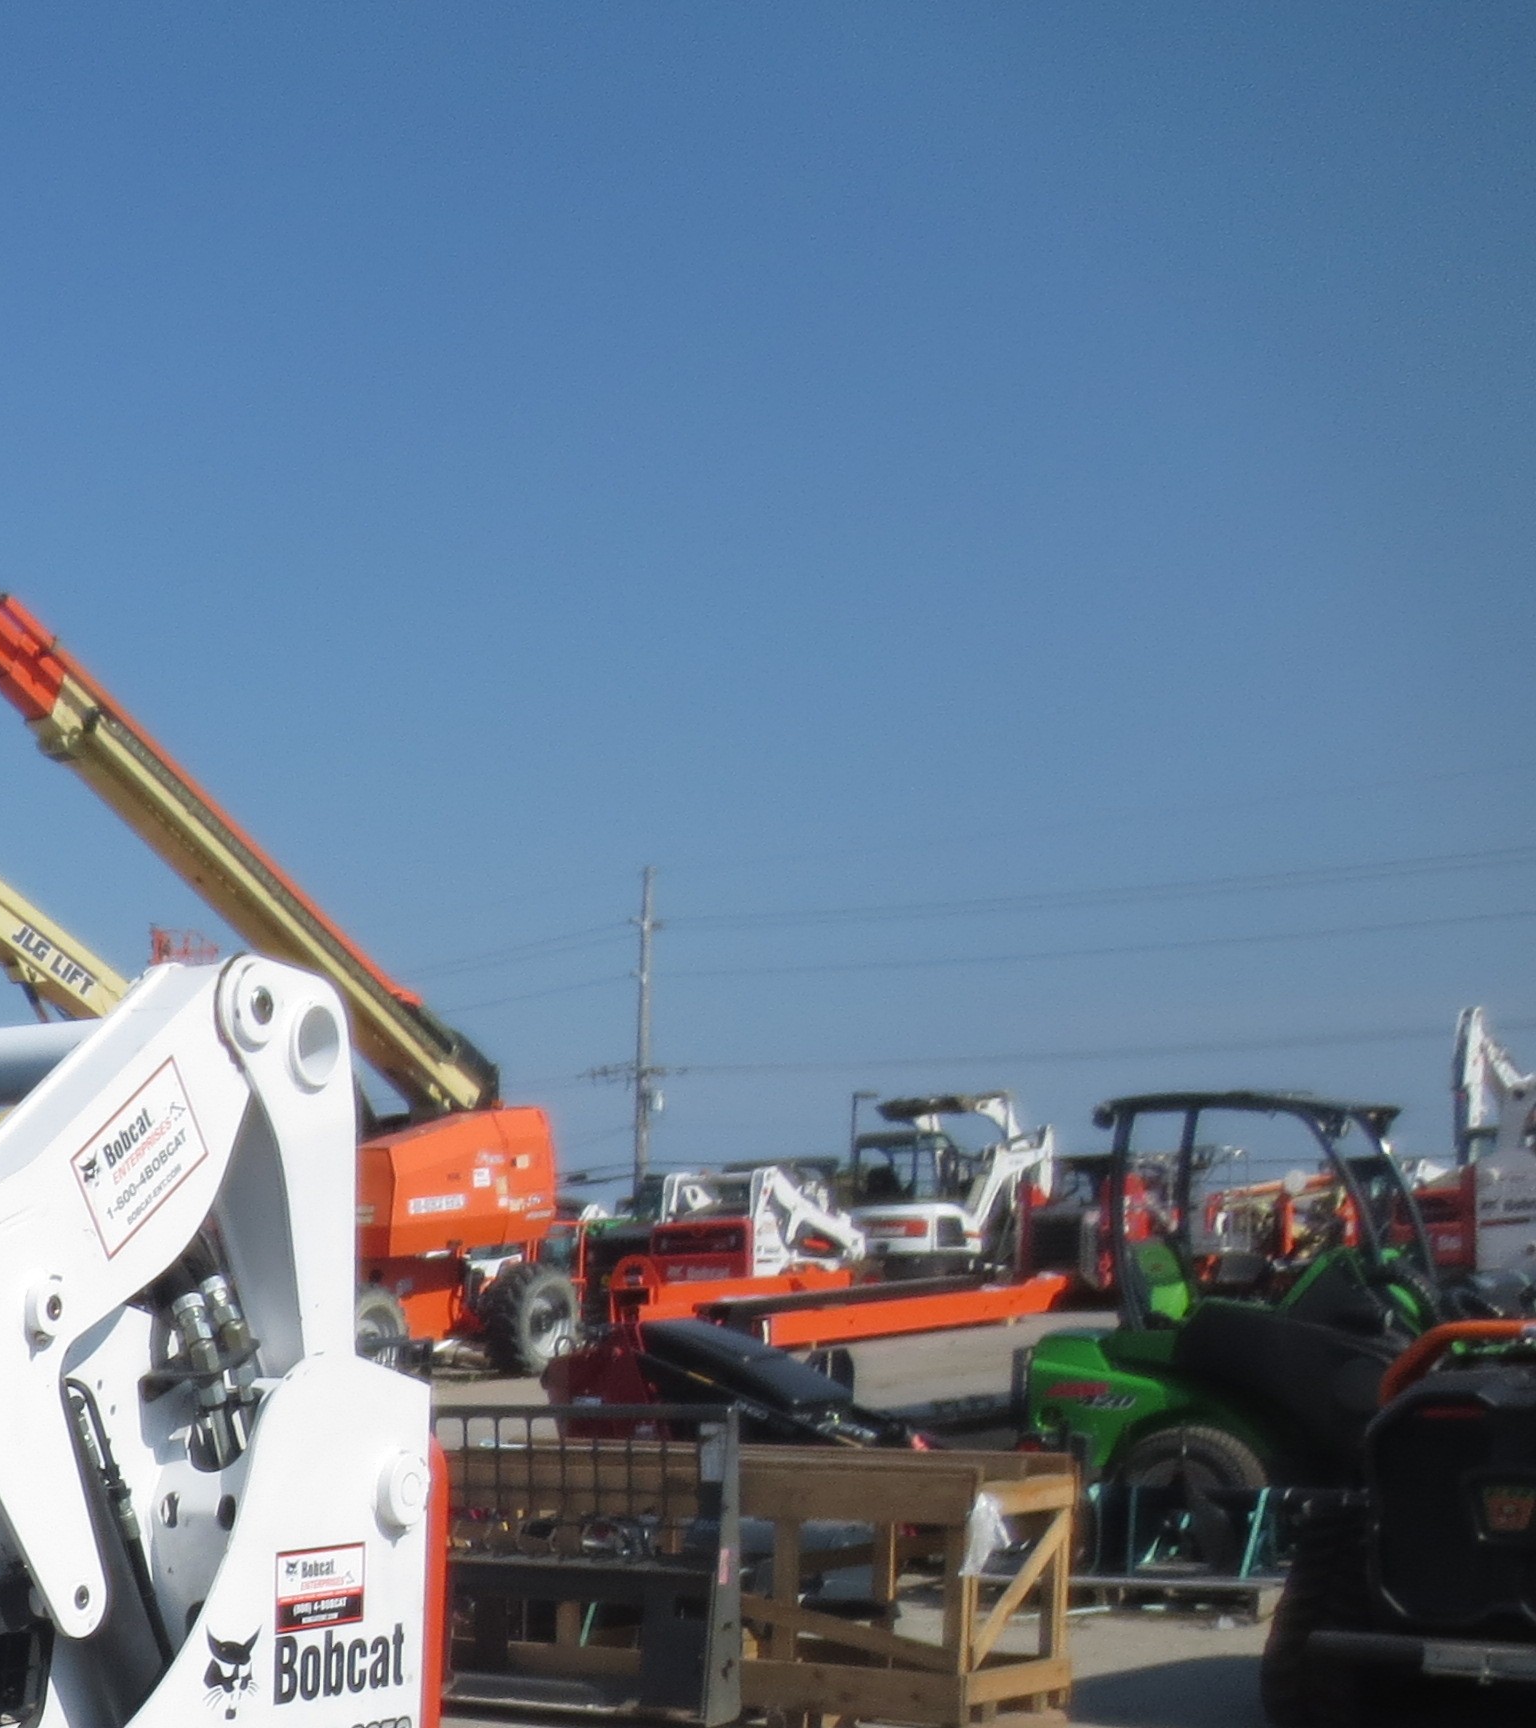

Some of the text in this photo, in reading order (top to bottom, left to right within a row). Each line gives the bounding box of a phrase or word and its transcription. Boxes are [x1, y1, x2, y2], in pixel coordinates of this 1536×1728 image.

[11, 926, 95, 995] JLG LIFT
[103, 1107, 153, 1169] Bobcat
[112, 1117, 173, 1185] ENTERPRISES
[107, 1128, 188, 1220] 1-800-4BOBCAT
[301, 1559, 335, 1578] Bobcat
[274, 1623, 404, 1705] Bobcat
